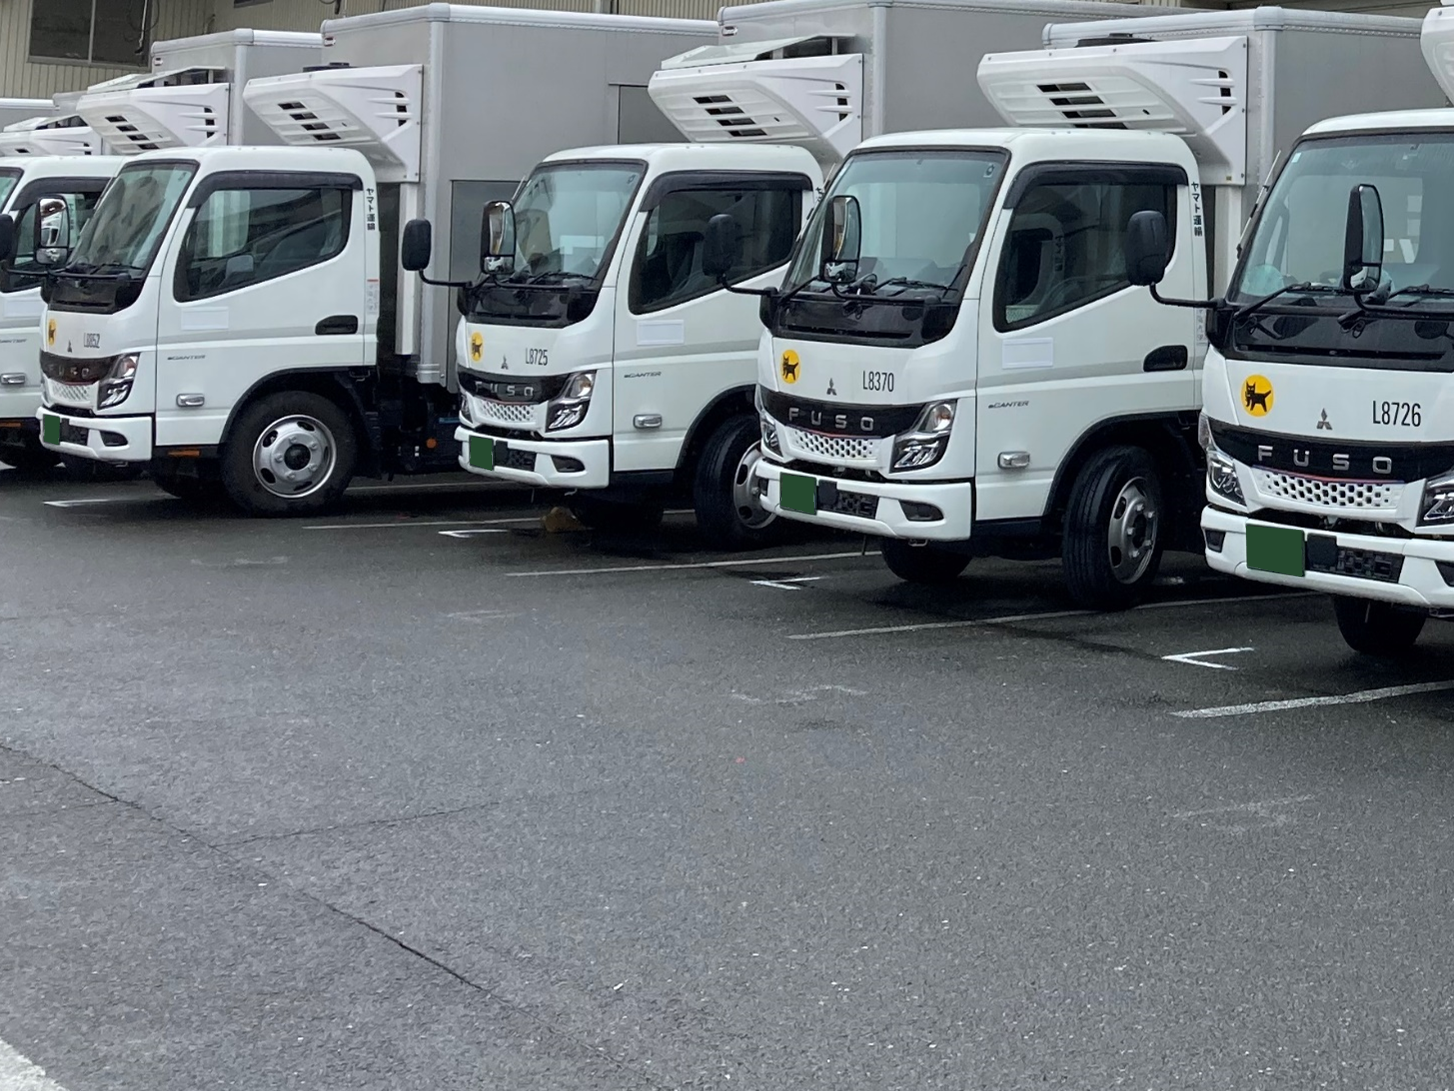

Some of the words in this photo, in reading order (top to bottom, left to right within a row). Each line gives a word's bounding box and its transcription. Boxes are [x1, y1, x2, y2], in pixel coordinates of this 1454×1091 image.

[863, 370, 894, 392] L8370
[788, 407, 874, 431] FUSO
[1372, 400, 1422, 427] L8726
[1258, 445, 1393, 474] FUSO
